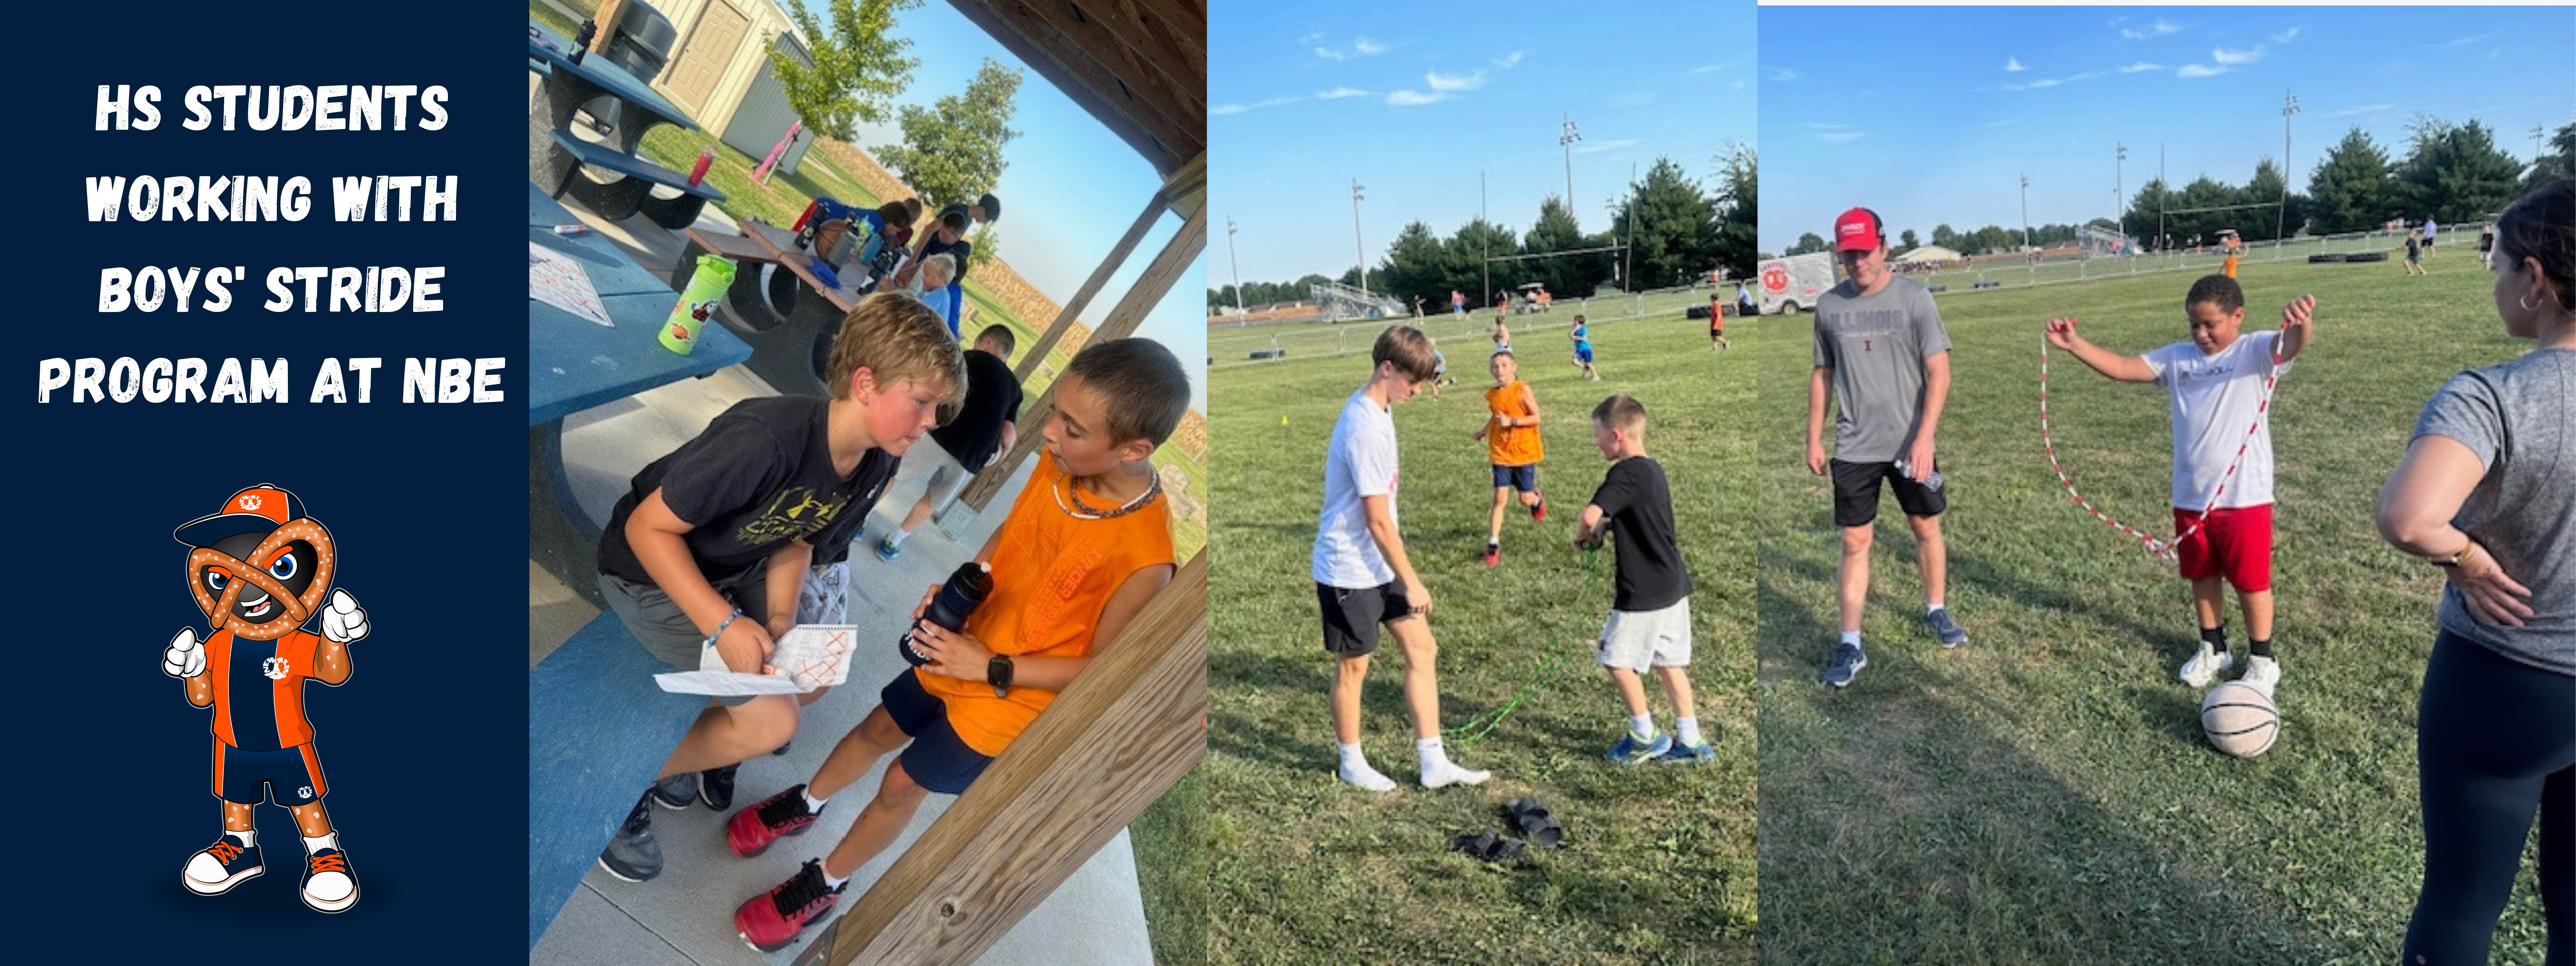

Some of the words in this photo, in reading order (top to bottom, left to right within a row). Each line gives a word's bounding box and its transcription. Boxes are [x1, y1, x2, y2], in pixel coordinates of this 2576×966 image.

[1830, 309, 1904, 331] ILLINOIS
[1059, 548, 1102, 598] UNDER
[1027, 595, 1064, 650] ARMO
